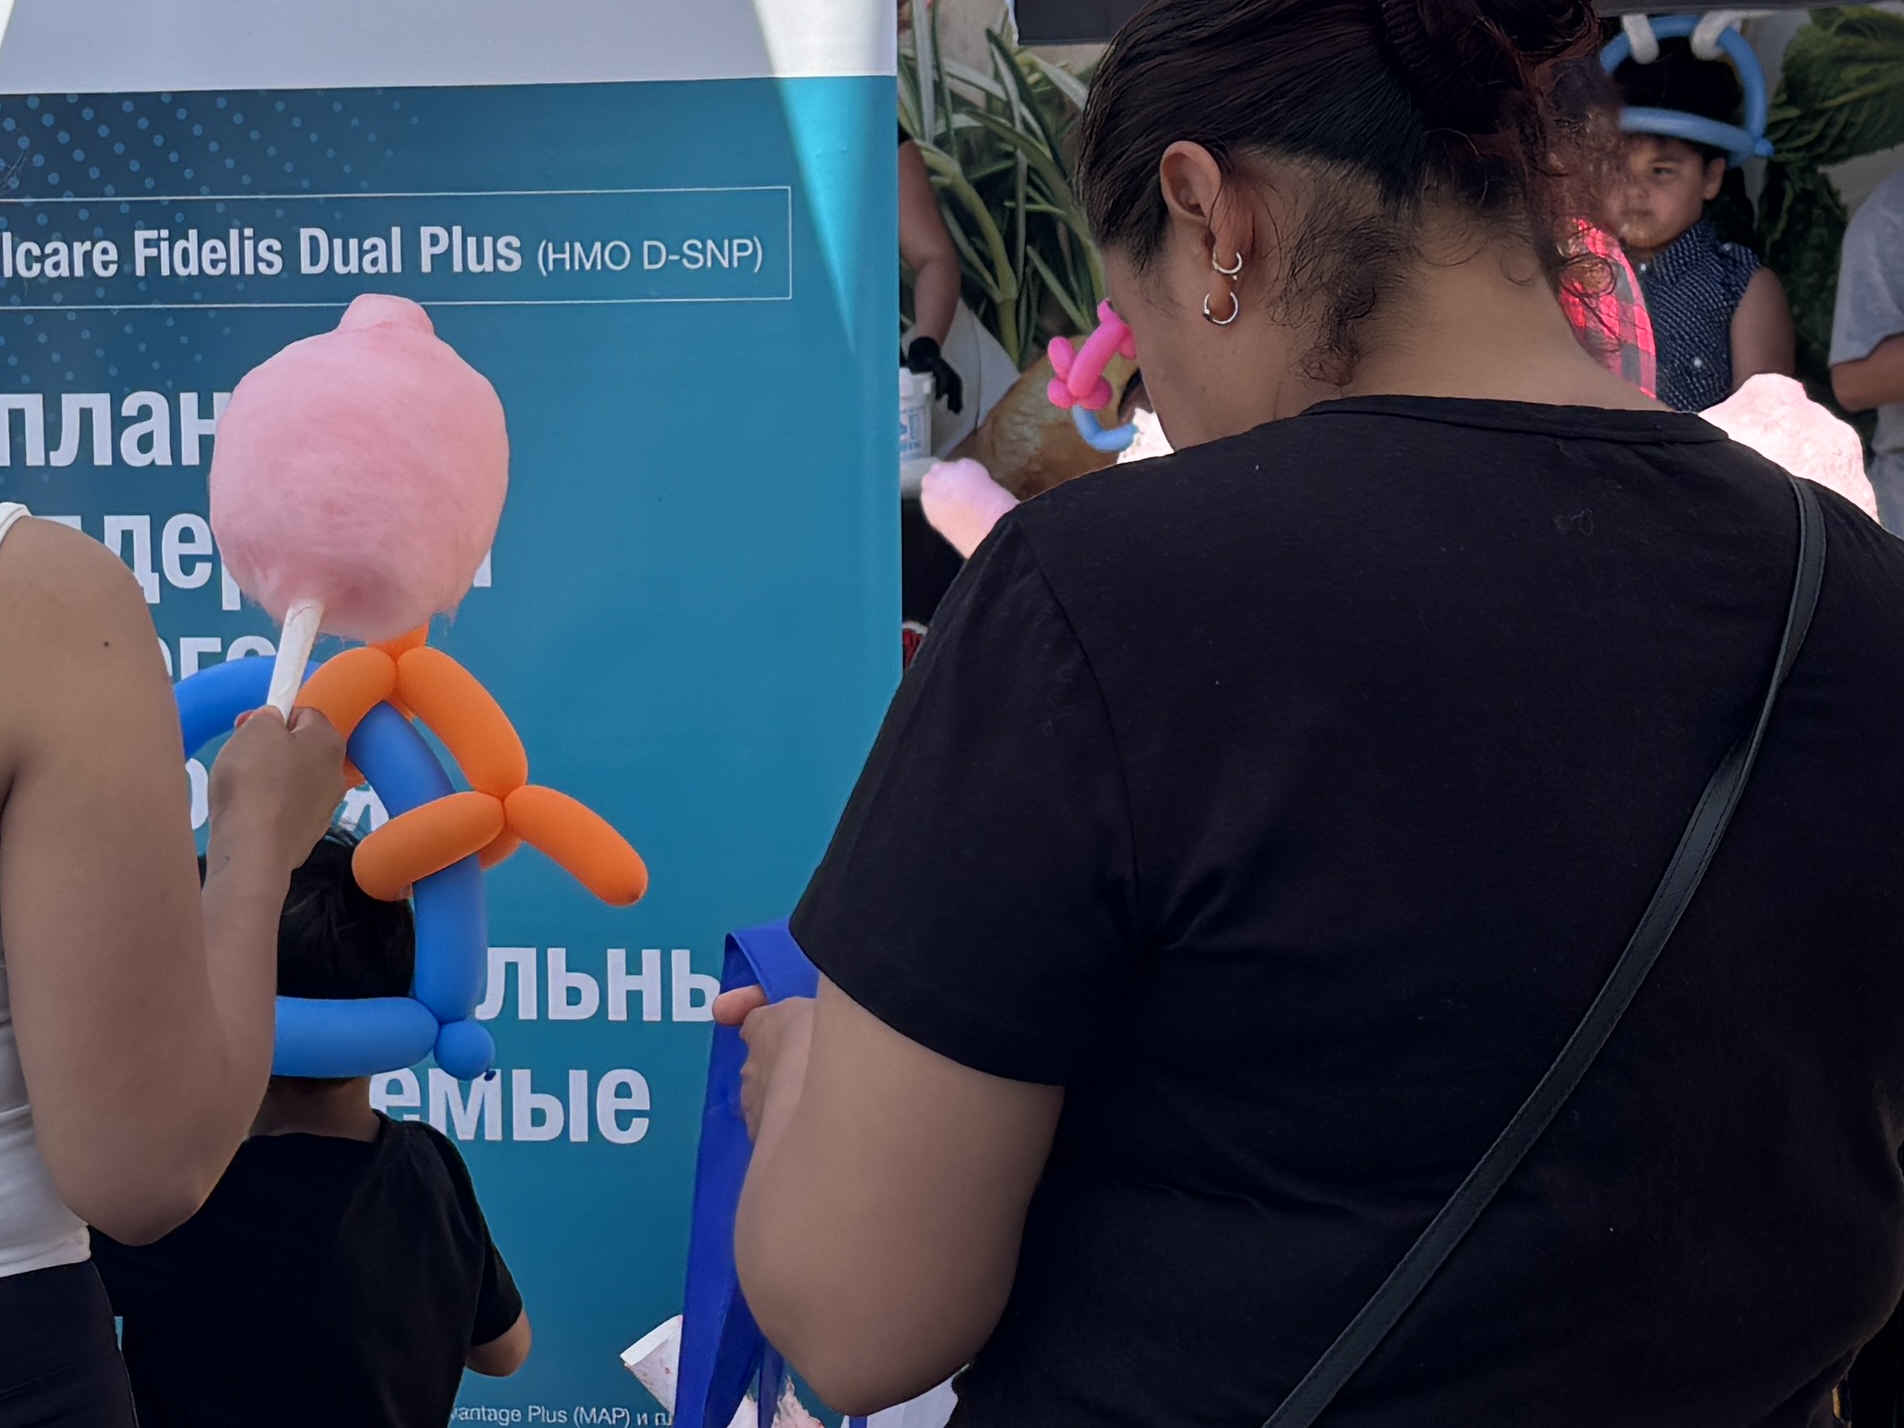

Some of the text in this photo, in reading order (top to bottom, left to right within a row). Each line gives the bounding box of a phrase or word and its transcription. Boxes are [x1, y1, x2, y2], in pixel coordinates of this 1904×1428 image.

[134, 228, 284, 279] Fidelis
[299, 226, 403, 276] Dual
[418, 224, 522, 274] Plus
[536, 240, 632, 277] (HMO
[641, 236, 764, 274] D-SNP)
[528, 1405, 567, 1424] Plus
[573, 1406, 630, 1428] (MAP)
